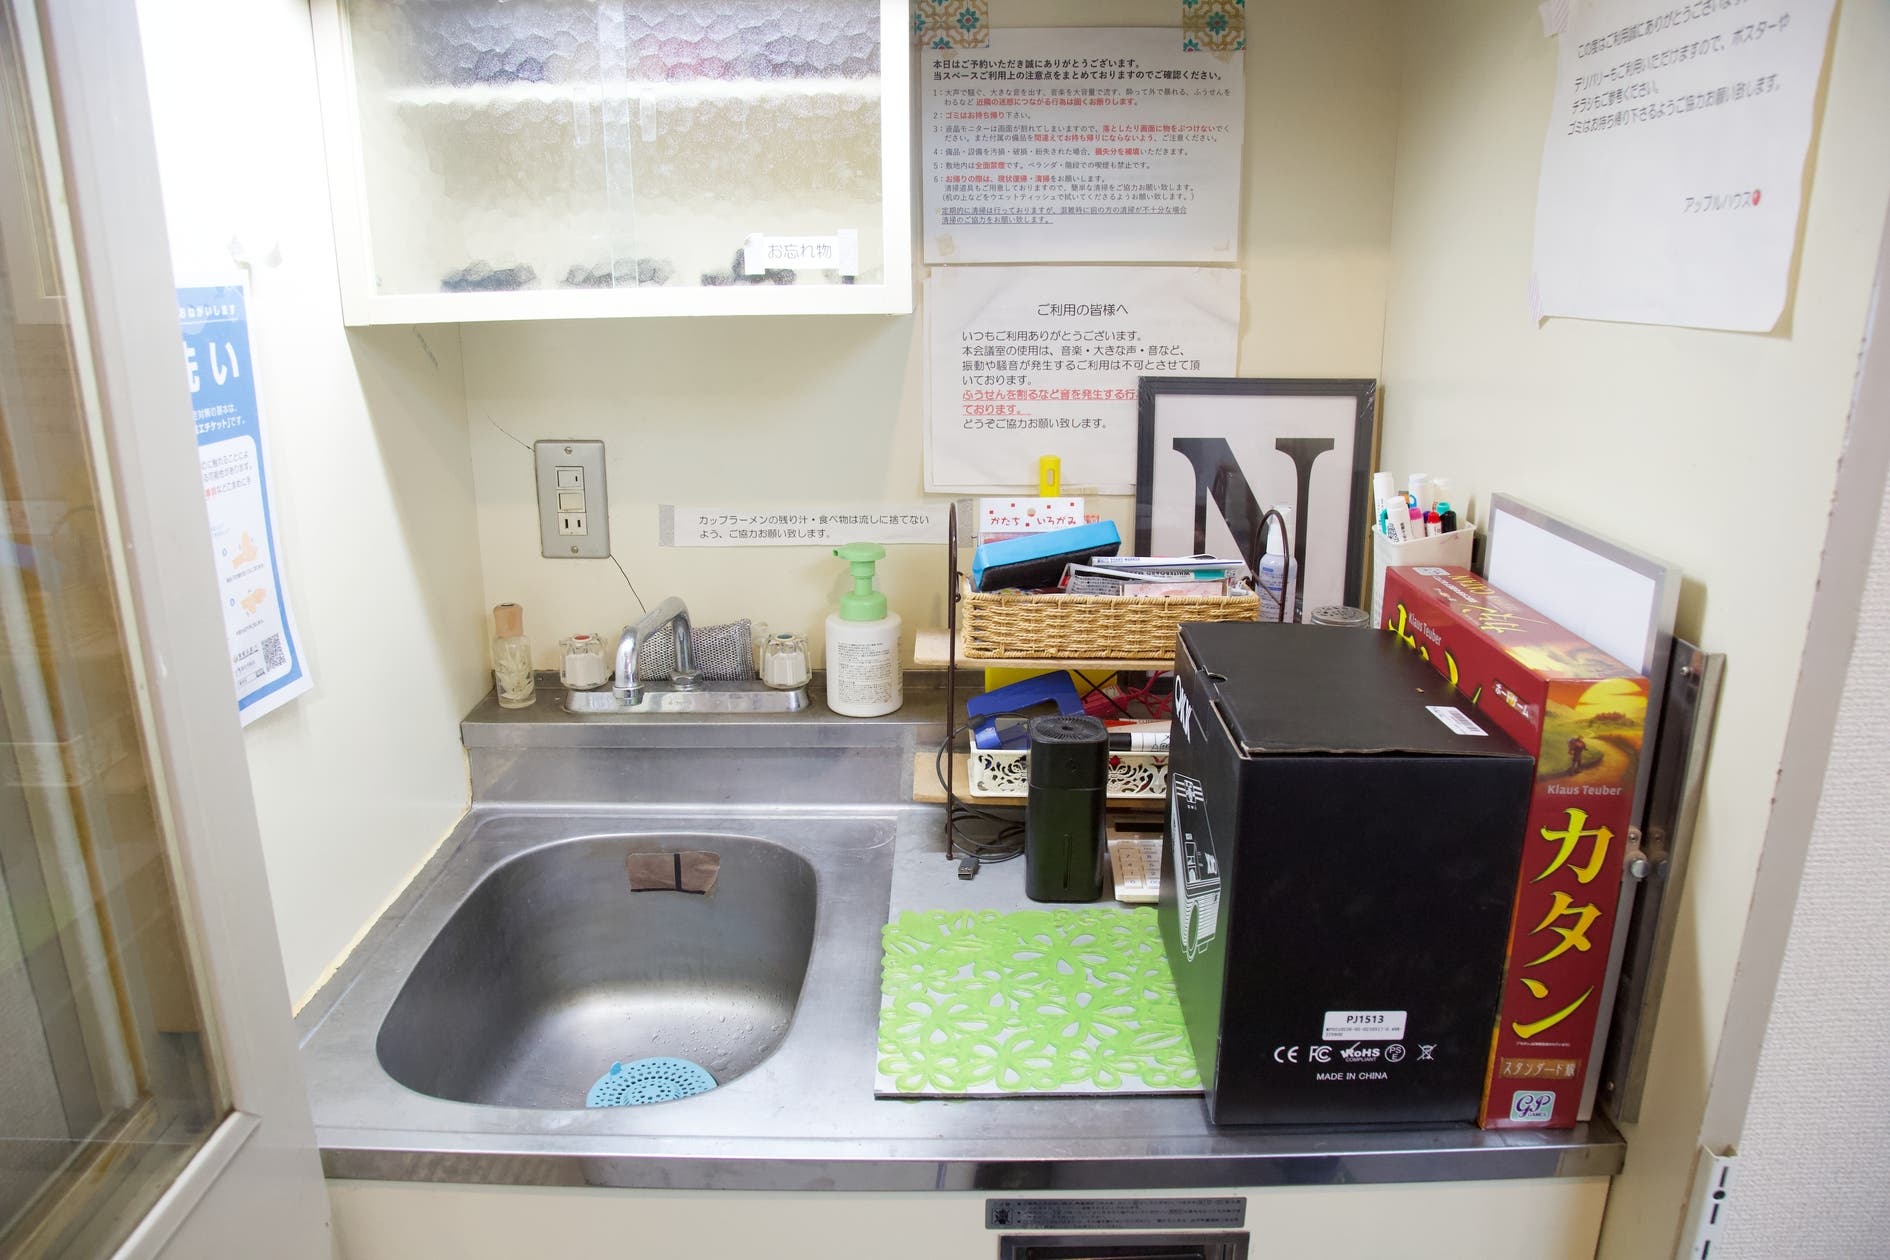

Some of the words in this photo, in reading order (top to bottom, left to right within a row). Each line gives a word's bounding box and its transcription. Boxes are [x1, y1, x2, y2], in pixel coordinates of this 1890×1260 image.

[933, 58, 1140, 70] 本日はご予約いただき誠にありがとうございます。
[933, 70, 1222, 82] 当スペースご利用上の注意点をまとめておりますのでご確認ください。
[768, 243, 832, 259] お忘れ物
[1037, 303, 1129, 317] ご利用の皆様へ
[962, 330, 1143, 342] いつもご利用ありがとうございます。
[962, 345, 1186, 356] 本会議室の使用は、音楽・大きな声・音など、
[962, 359, 1200, 372] 振動や騒音が発生するご利用は不可とさせて頂
[962, 374, 1033, 386] いております。
[962, 389, 1138, 400] ふうせんを割るなど音を発生する行
[963, 403, 1025, 415] ております。
[963, 418, 1107, 430] どうぞご協力お願い致します。
[698, 514, 929, 526] カップラーメンの残り汁・食べ物は流しに捨てない
[990, 516, 1021, 526] かたち
[1036, 516, 1077, 526] いろがみ
[699, 528, 831, 540] よう、ご協力お願い致します。
[1547, 784, 1579, 795] Klaus
[1583, 785, 1622, 796] Teuber
[1511, 806, 1616, 1040] カタン
[1346, 1015, 1385, 1024] PJ1513
[1316, 1072, 1343, 1081] MADE
[1346, 1072, 1356, 1081] IN
[1359, 1071, 1388, 1080] CHINA
